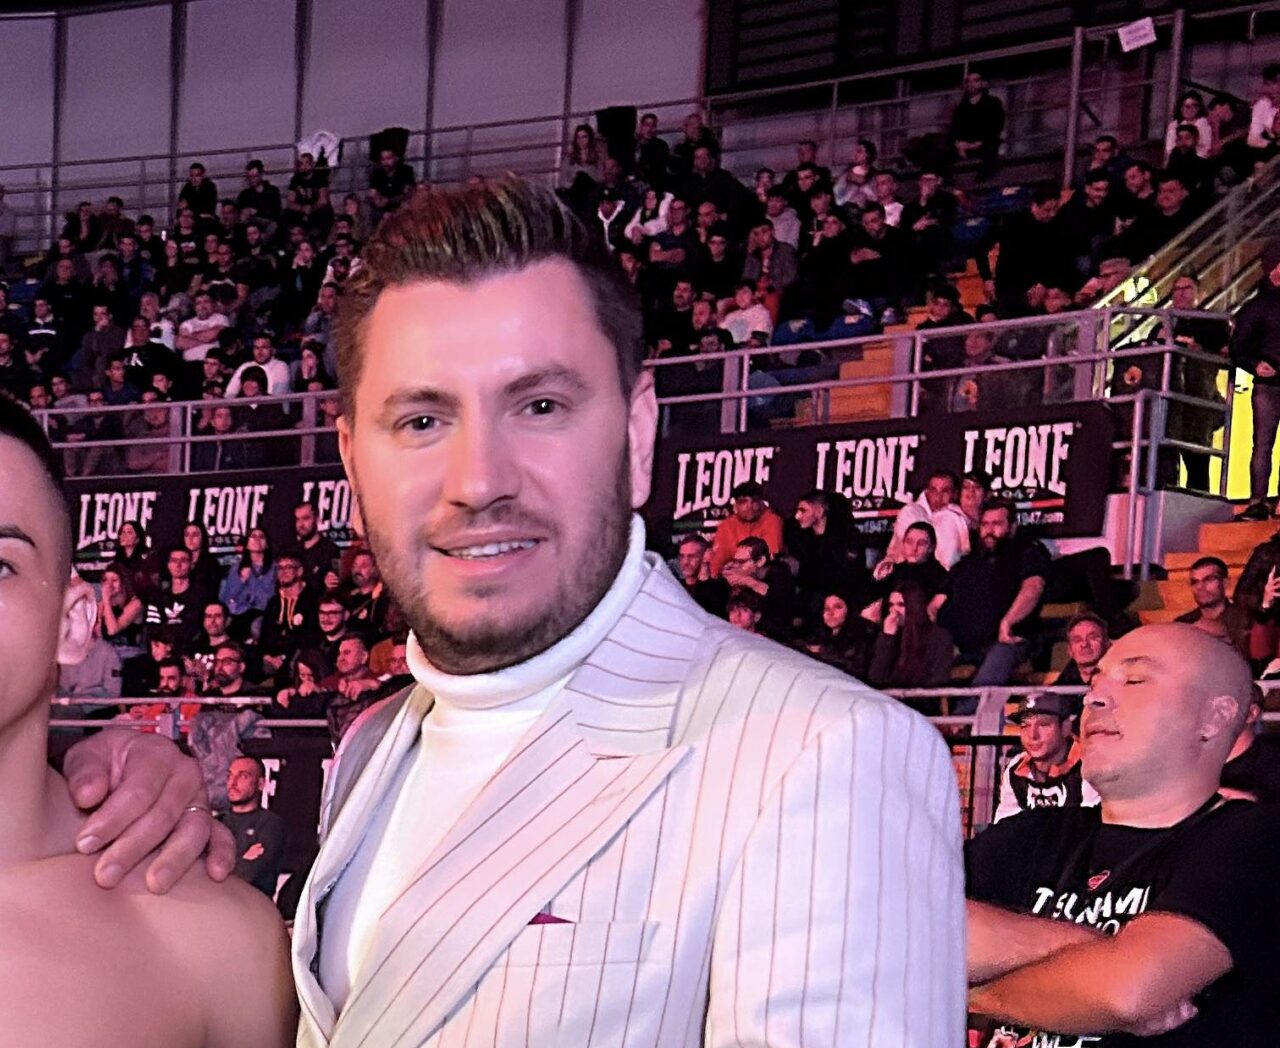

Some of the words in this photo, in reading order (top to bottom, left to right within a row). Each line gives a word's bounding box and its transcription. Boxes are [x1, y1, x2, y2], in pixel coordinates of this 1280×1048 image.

[673, 447, 774, 520] LEONE
[815, 435, 919, 504] LEONE
[965, 422, 1073, 496] LEONE
[77, 491, 157, 550] LEONE
[188, 484, 269, 537] LEONE
[702, 508, 730, 519] 194
[852, 498, 884, 509] 947
